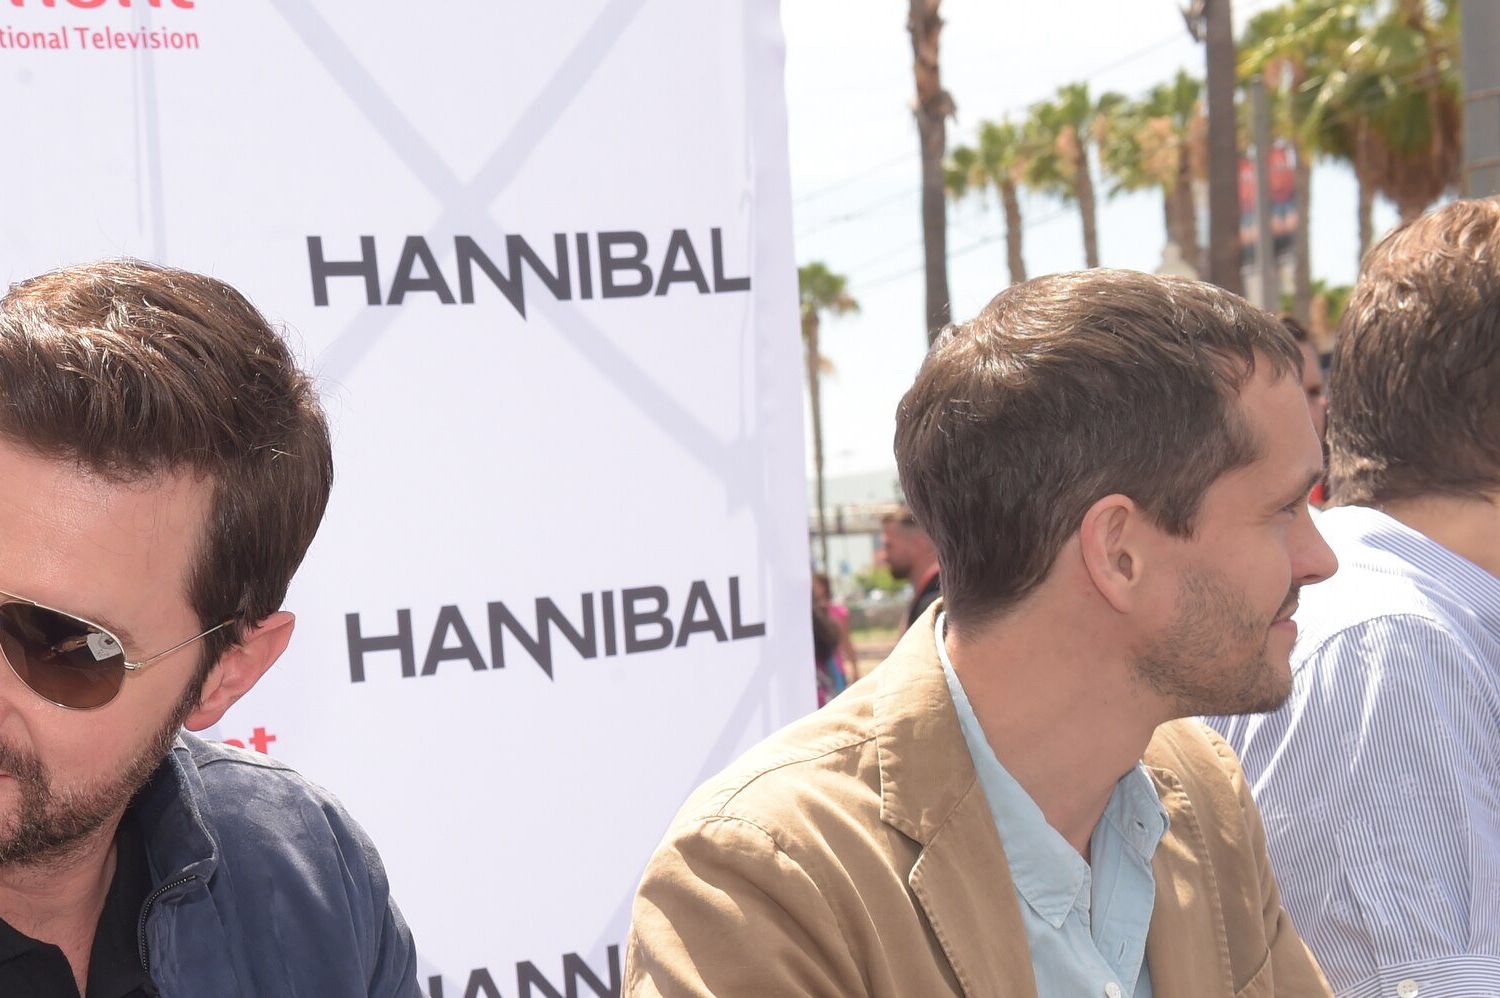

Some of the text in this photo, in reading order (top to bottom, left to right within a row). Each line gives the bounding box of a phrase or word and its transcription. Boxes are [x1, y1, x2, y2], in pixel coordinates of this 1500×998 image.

[73, 27, 199, 50] Television
[306, 227, 752, 321] HANNIBAL
[345, 576, 766, 683] HANNIBAL
